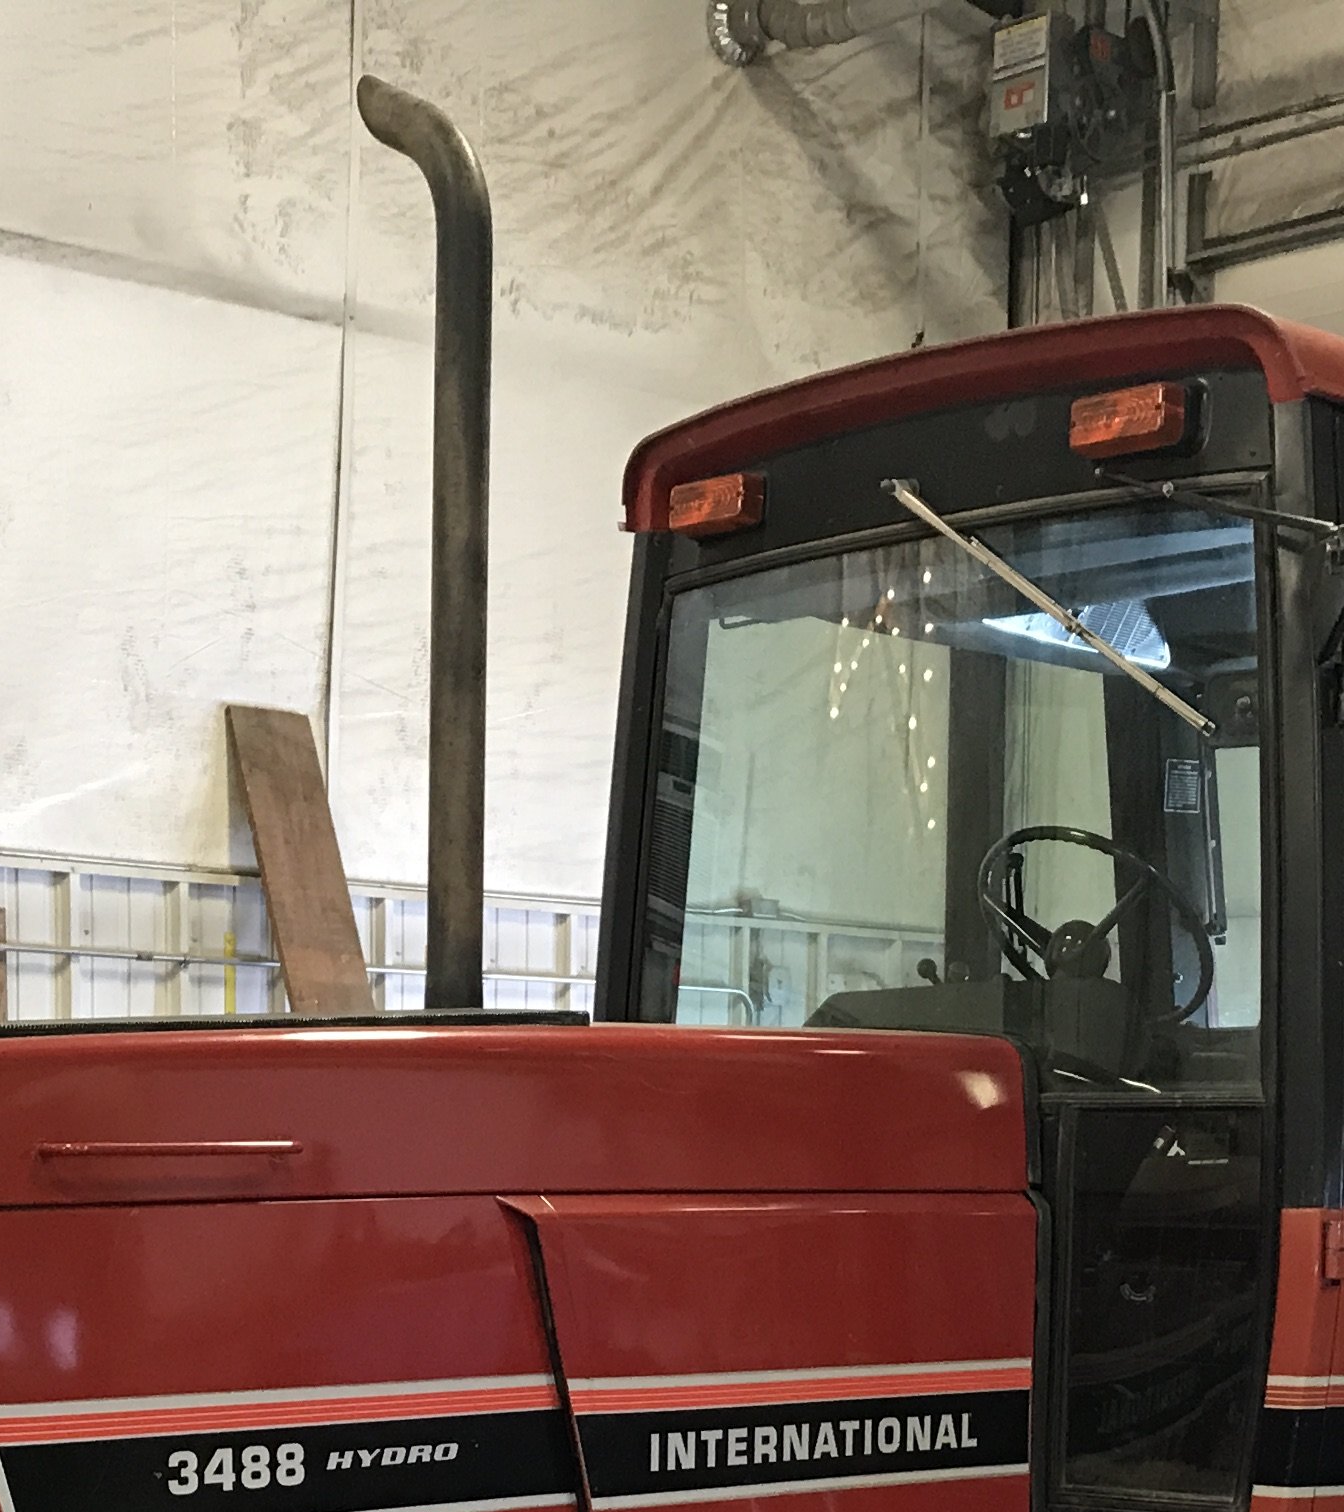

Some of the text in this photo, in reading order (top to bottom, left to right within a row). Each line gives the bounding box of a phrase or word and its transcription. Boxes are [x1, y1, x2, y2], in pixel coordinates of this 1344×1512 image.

[167, 1443, 458, 1497] 3488 HYDRO
[649, 1411, 978, 1473] INTERNATIONAL
